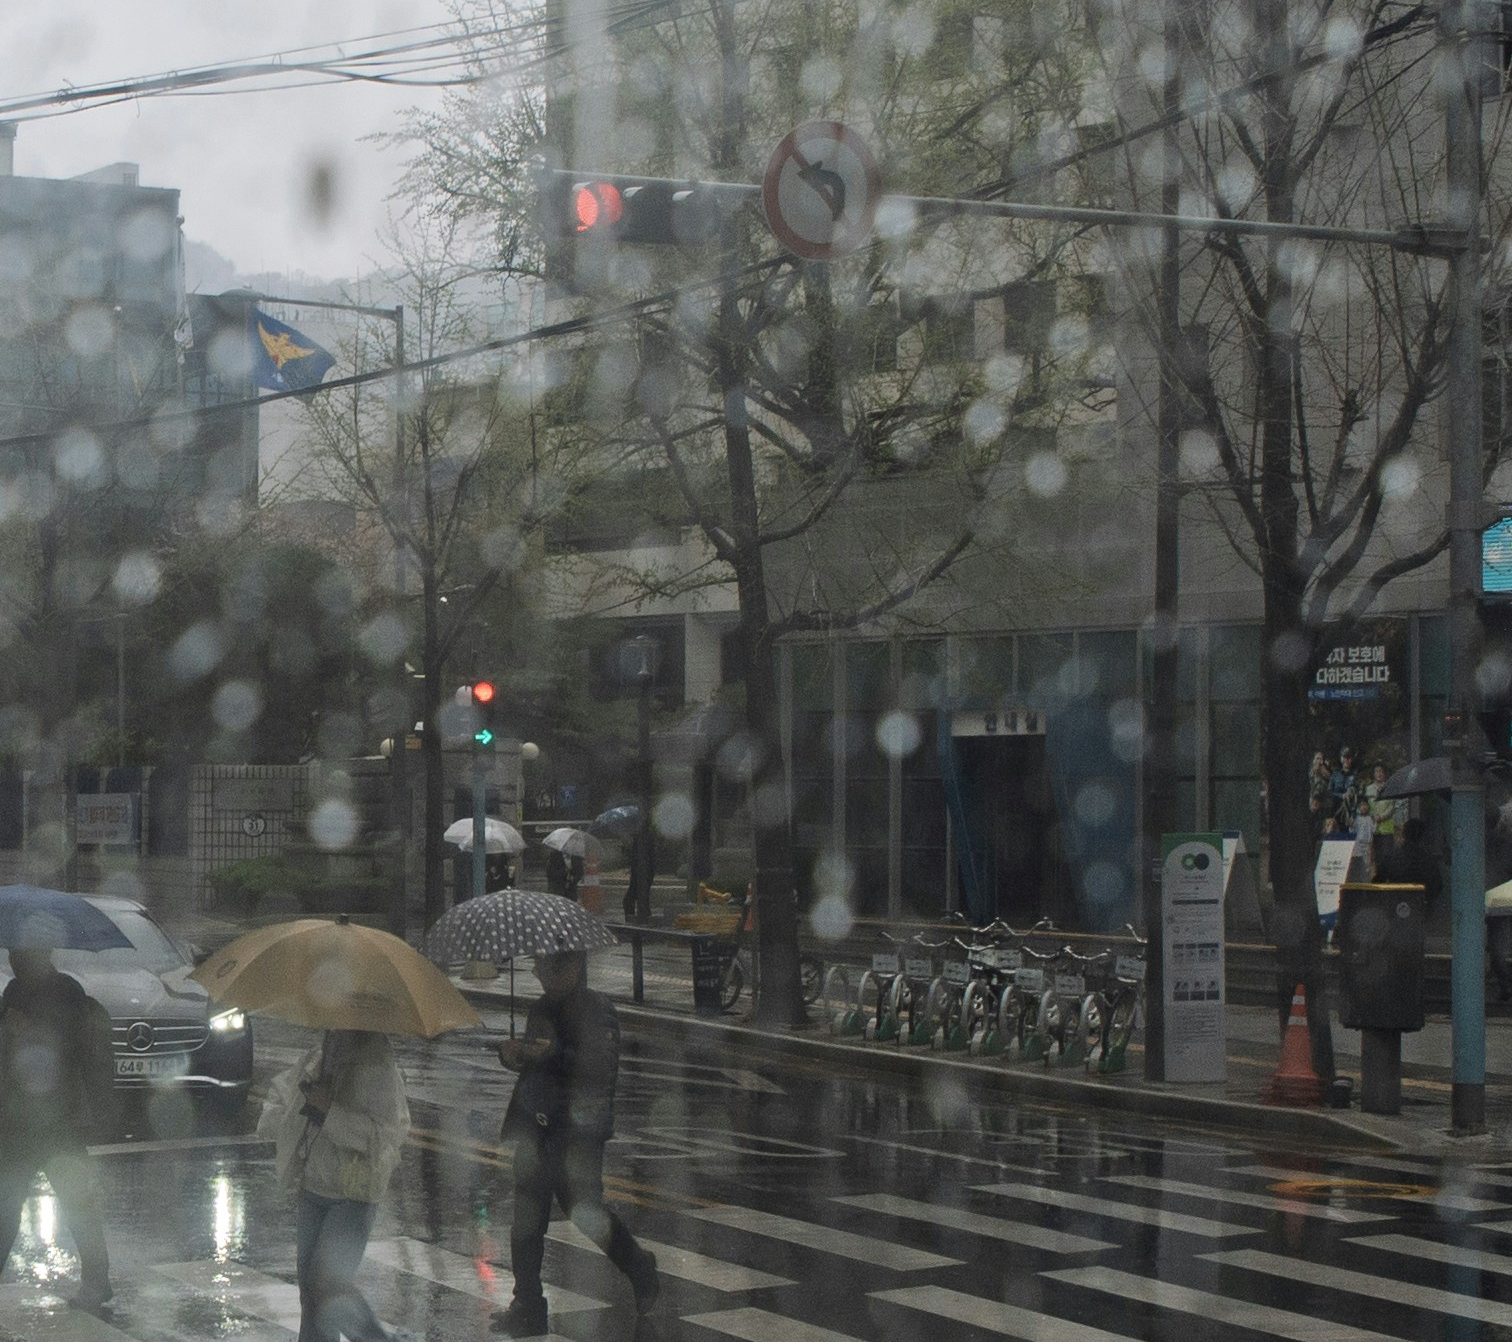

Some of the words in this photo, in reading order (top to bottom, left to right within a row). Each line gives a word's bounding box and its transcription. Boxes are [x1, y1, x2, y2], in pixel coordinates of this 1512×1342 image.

[1348, 645, 1385, 663] 보호에
[1316, 665, 1390, 684] 다하겠습니다
[984, 712, 1038, 732] 안내실
